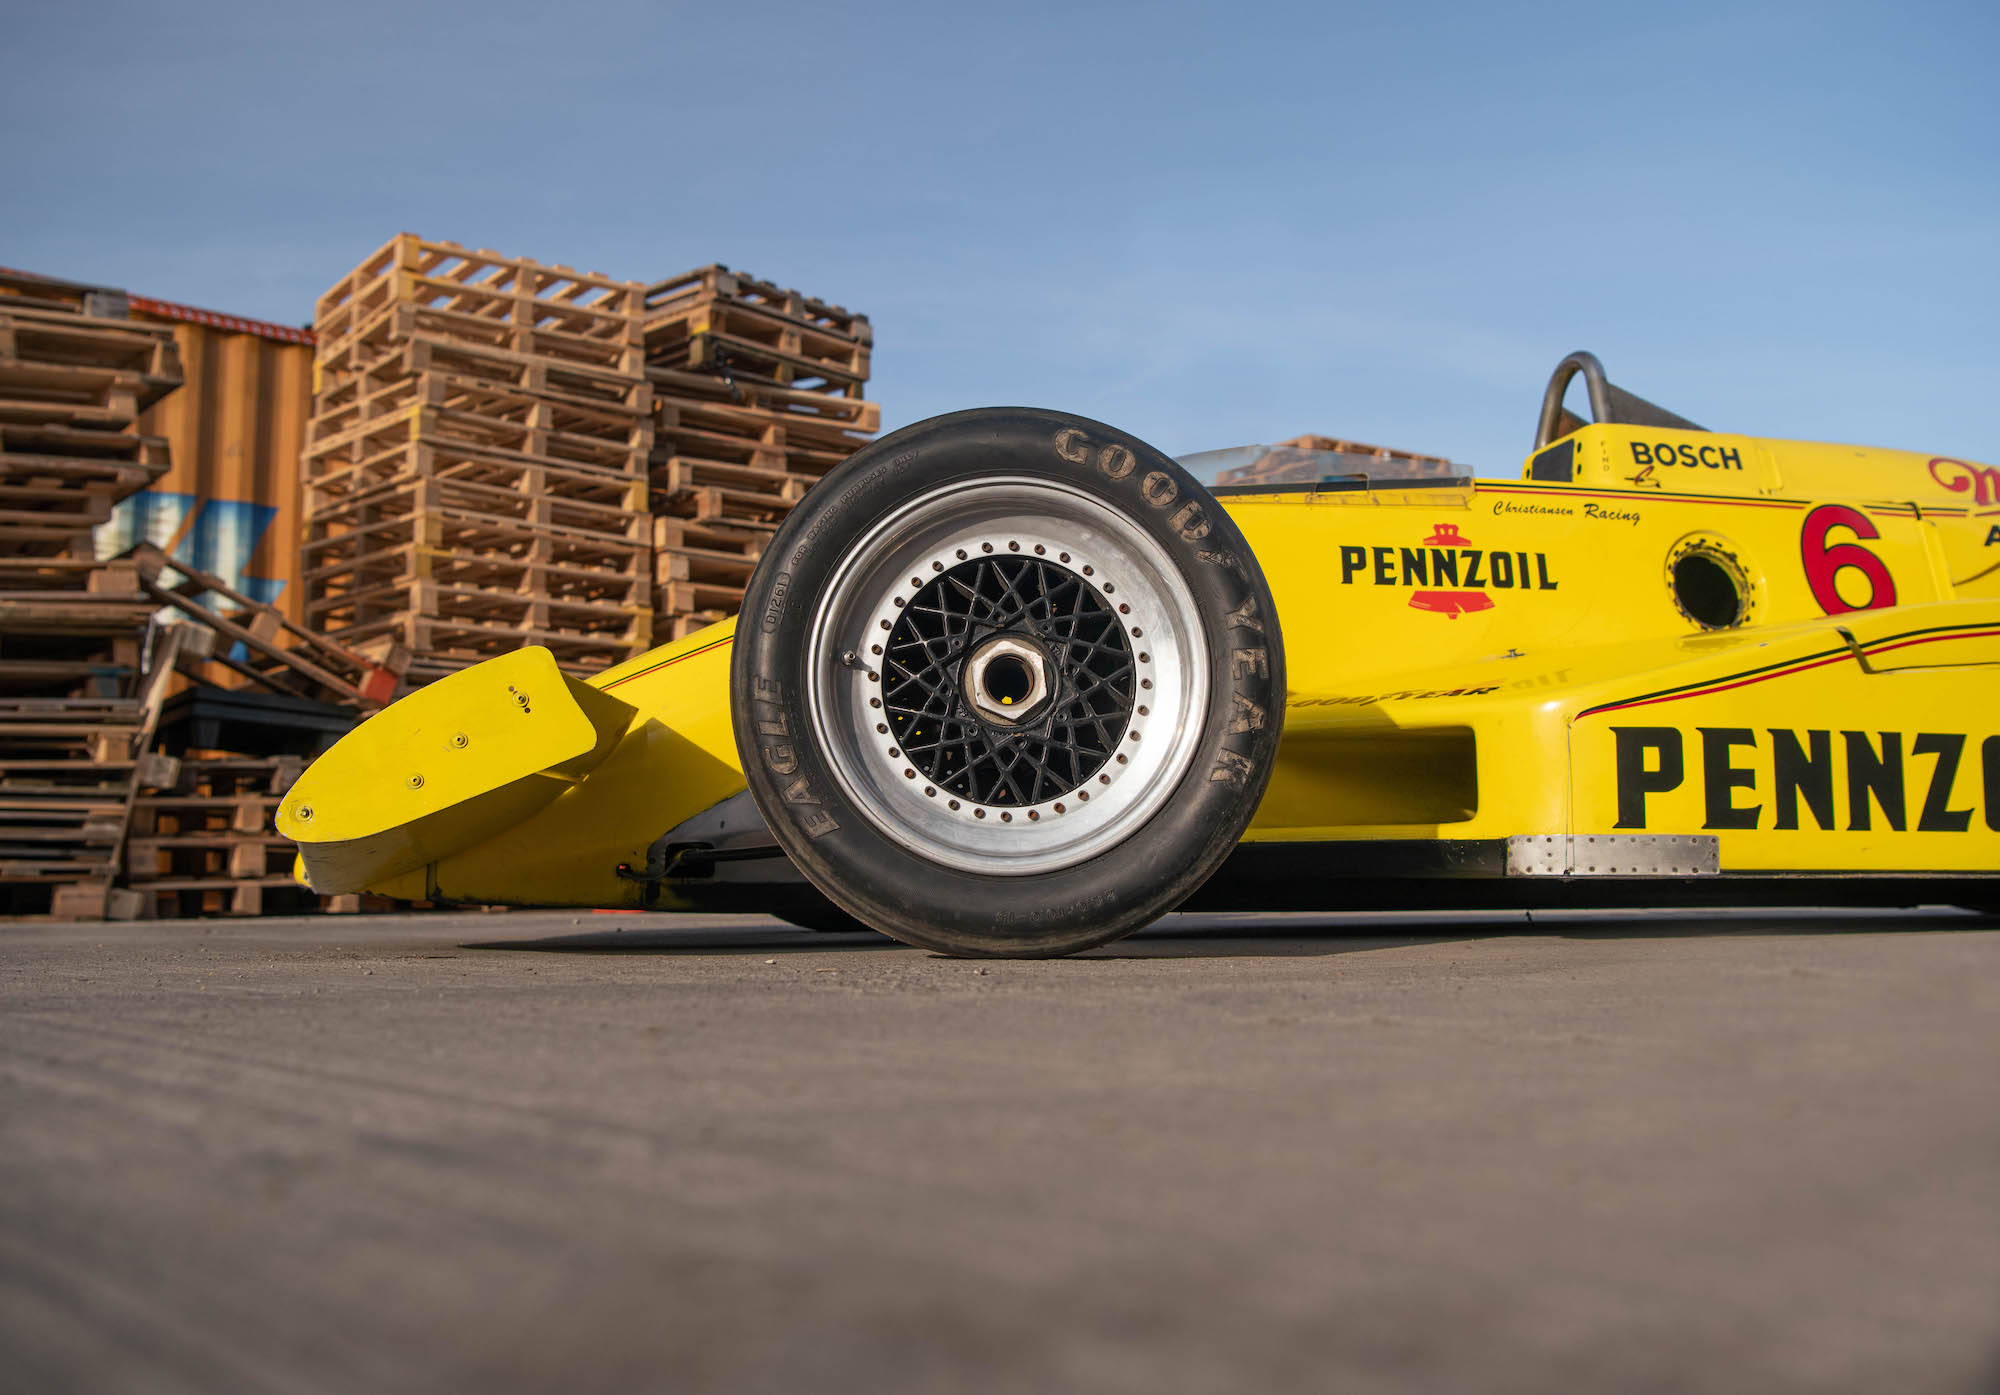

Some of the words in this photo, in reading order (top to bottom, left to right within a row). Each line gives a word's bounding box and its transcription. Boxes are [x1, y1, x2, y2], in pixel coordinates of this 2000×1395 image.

[1630, 441, 1743, 470] BOSCH
[1493, 500, 1574, 516] Christiansen
[1583, 503, 1641, 527] Racing
[1338, 545, 1559, 590] PENNZOIL
[1800, 504, 1897, 616] 6
[753, 674, 841, 839] EAGLE
